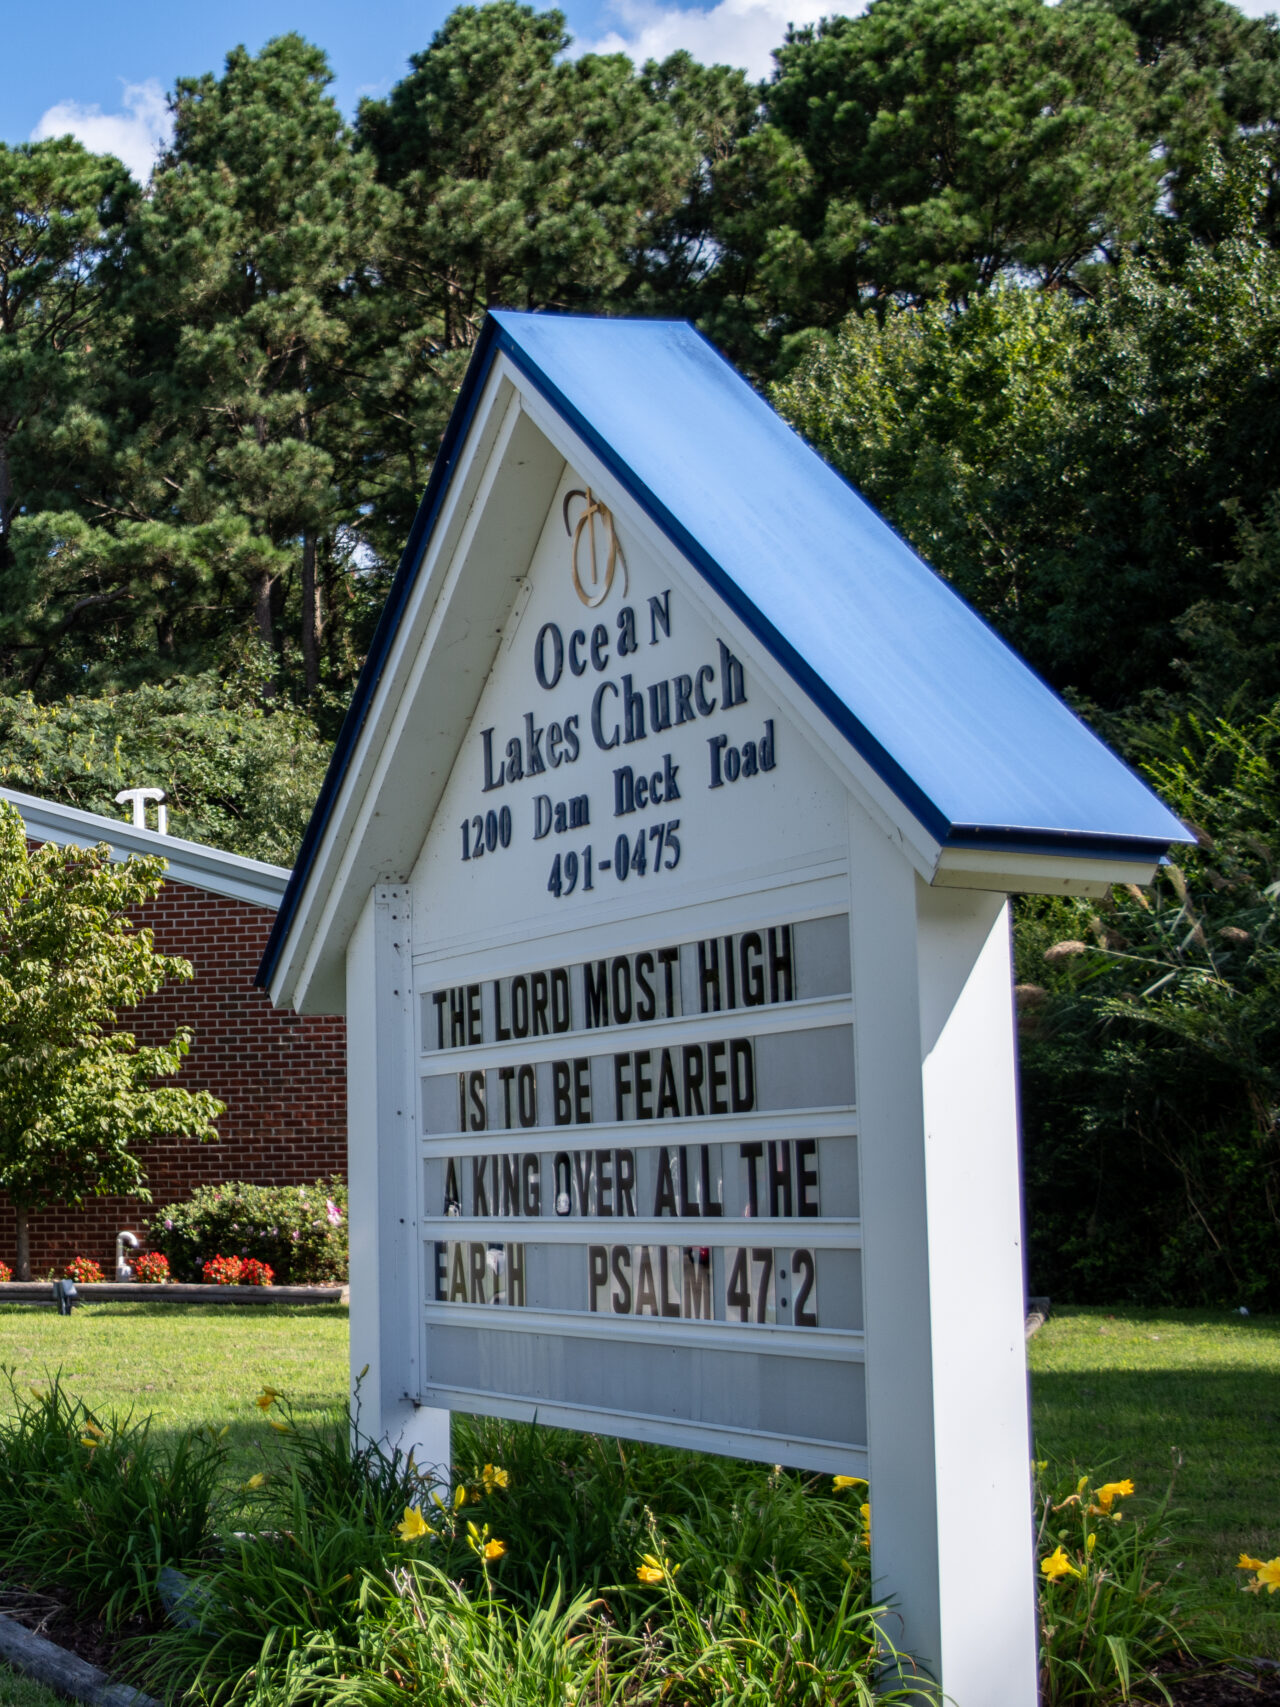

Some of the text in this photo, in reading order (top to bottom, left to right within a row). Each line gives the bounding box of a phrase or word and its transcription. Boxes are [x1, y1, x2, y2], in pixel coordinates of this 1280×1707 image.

[480, 712, 580, 792] Lakes
[460, 805, 511, 861] 1200
[532, 793, 590, 840] Dam
[547, 819, 681, 898] 491-0475
[433, 925, 793, 1049] THE LORD MOST HIGH
[460, 1038, 755, 1132] IS TO BE FEARED
[444, 1139, 818, 1217] A KING OVER ALL THE
[434, 1241, 817, 1327] EARTH PSALM 47:2
